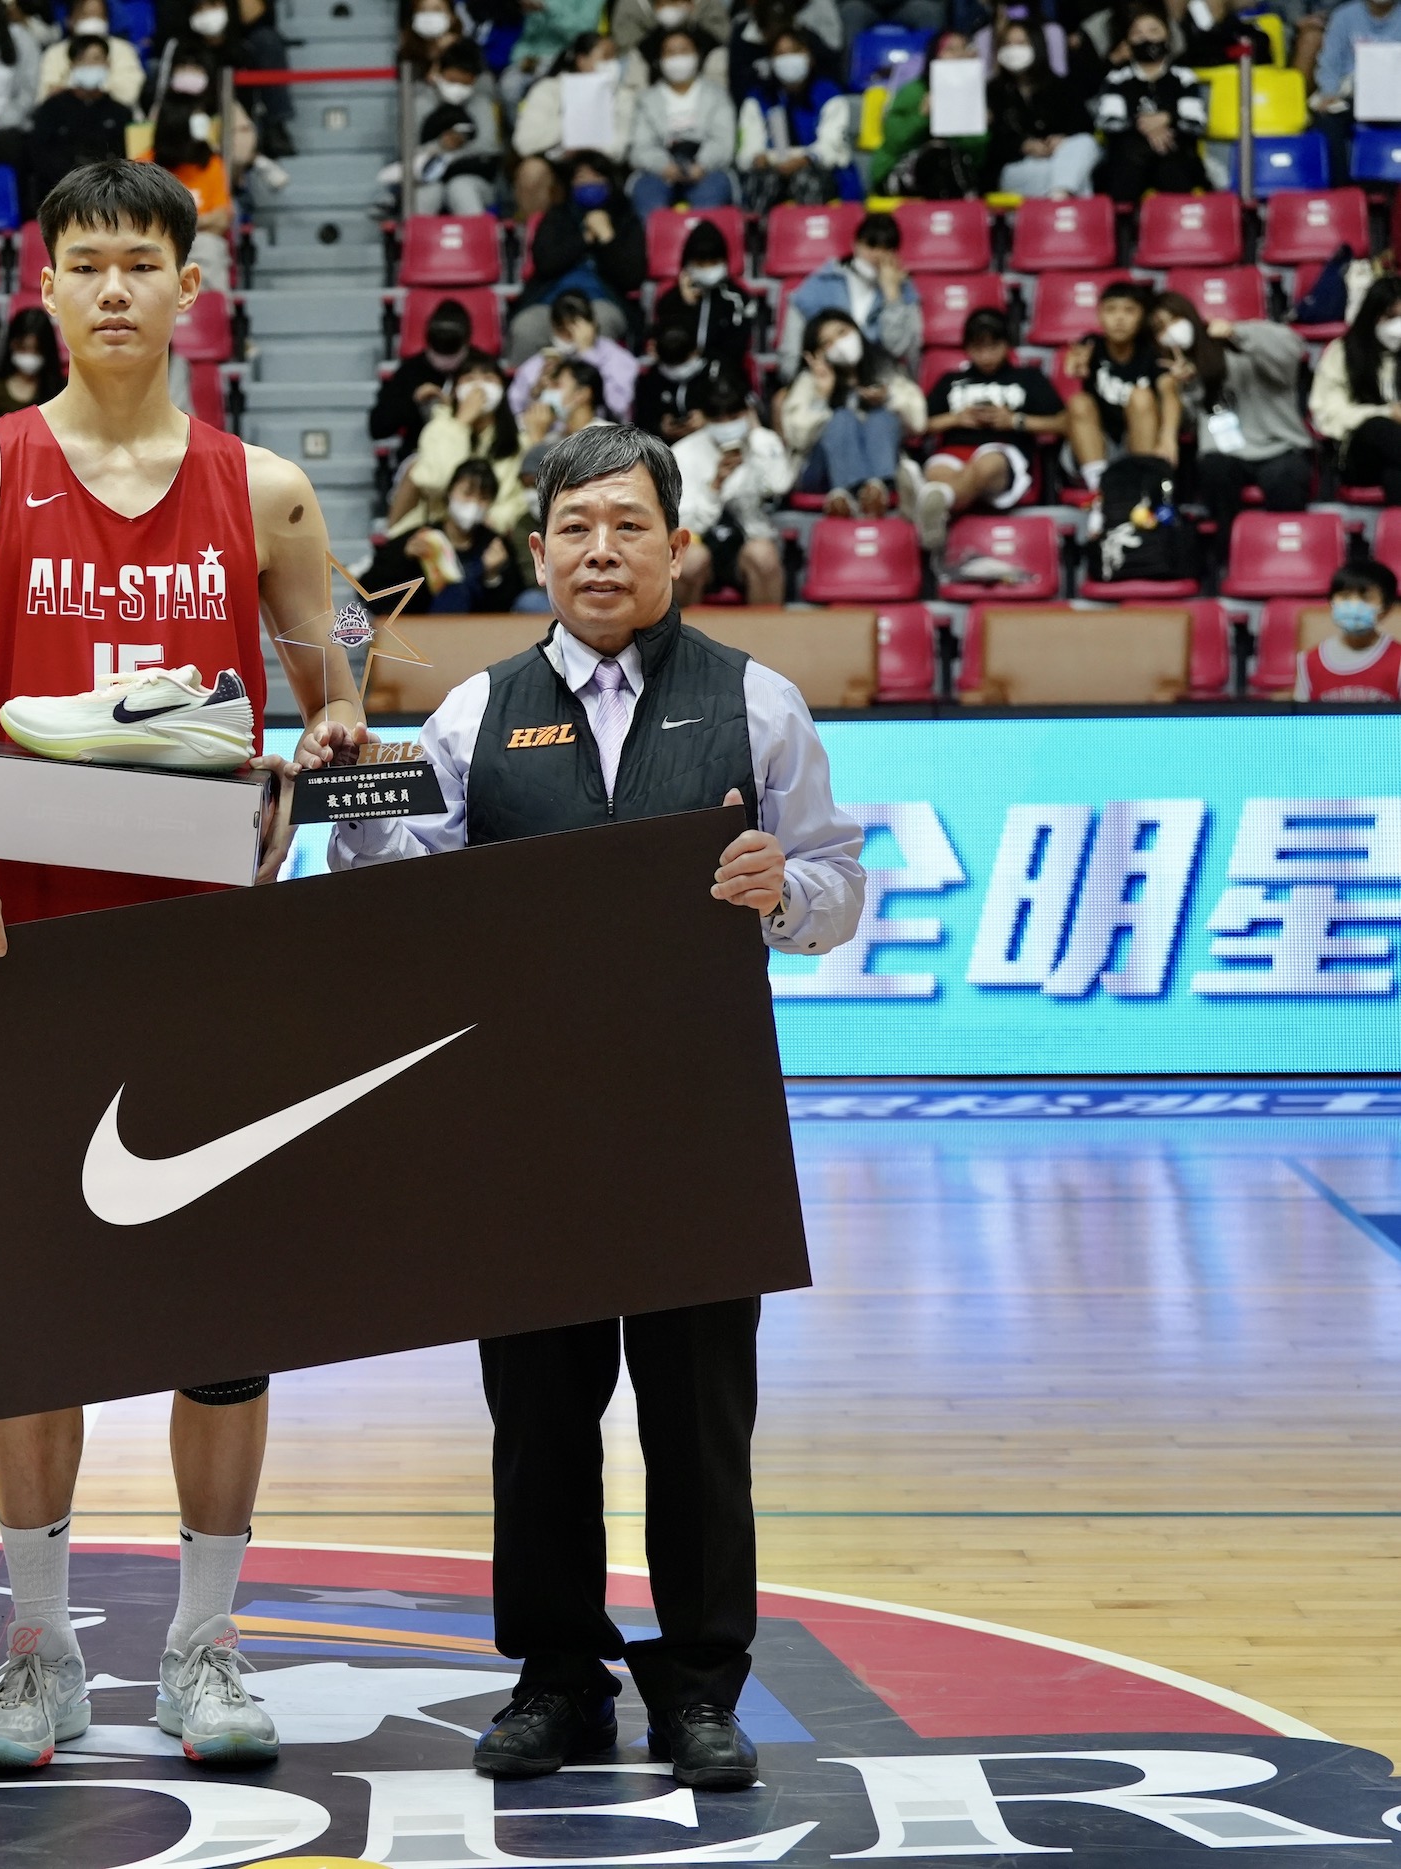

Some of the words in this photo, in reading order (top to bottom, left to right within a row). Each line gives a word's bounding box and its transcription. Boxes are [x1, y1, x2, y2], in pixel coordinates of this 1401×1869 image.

[27, 557, 227, 621] ALL-STAR
[327, 789, 410, 808] 最有價值球員
[770, 797, 1401, 998] 全明星
